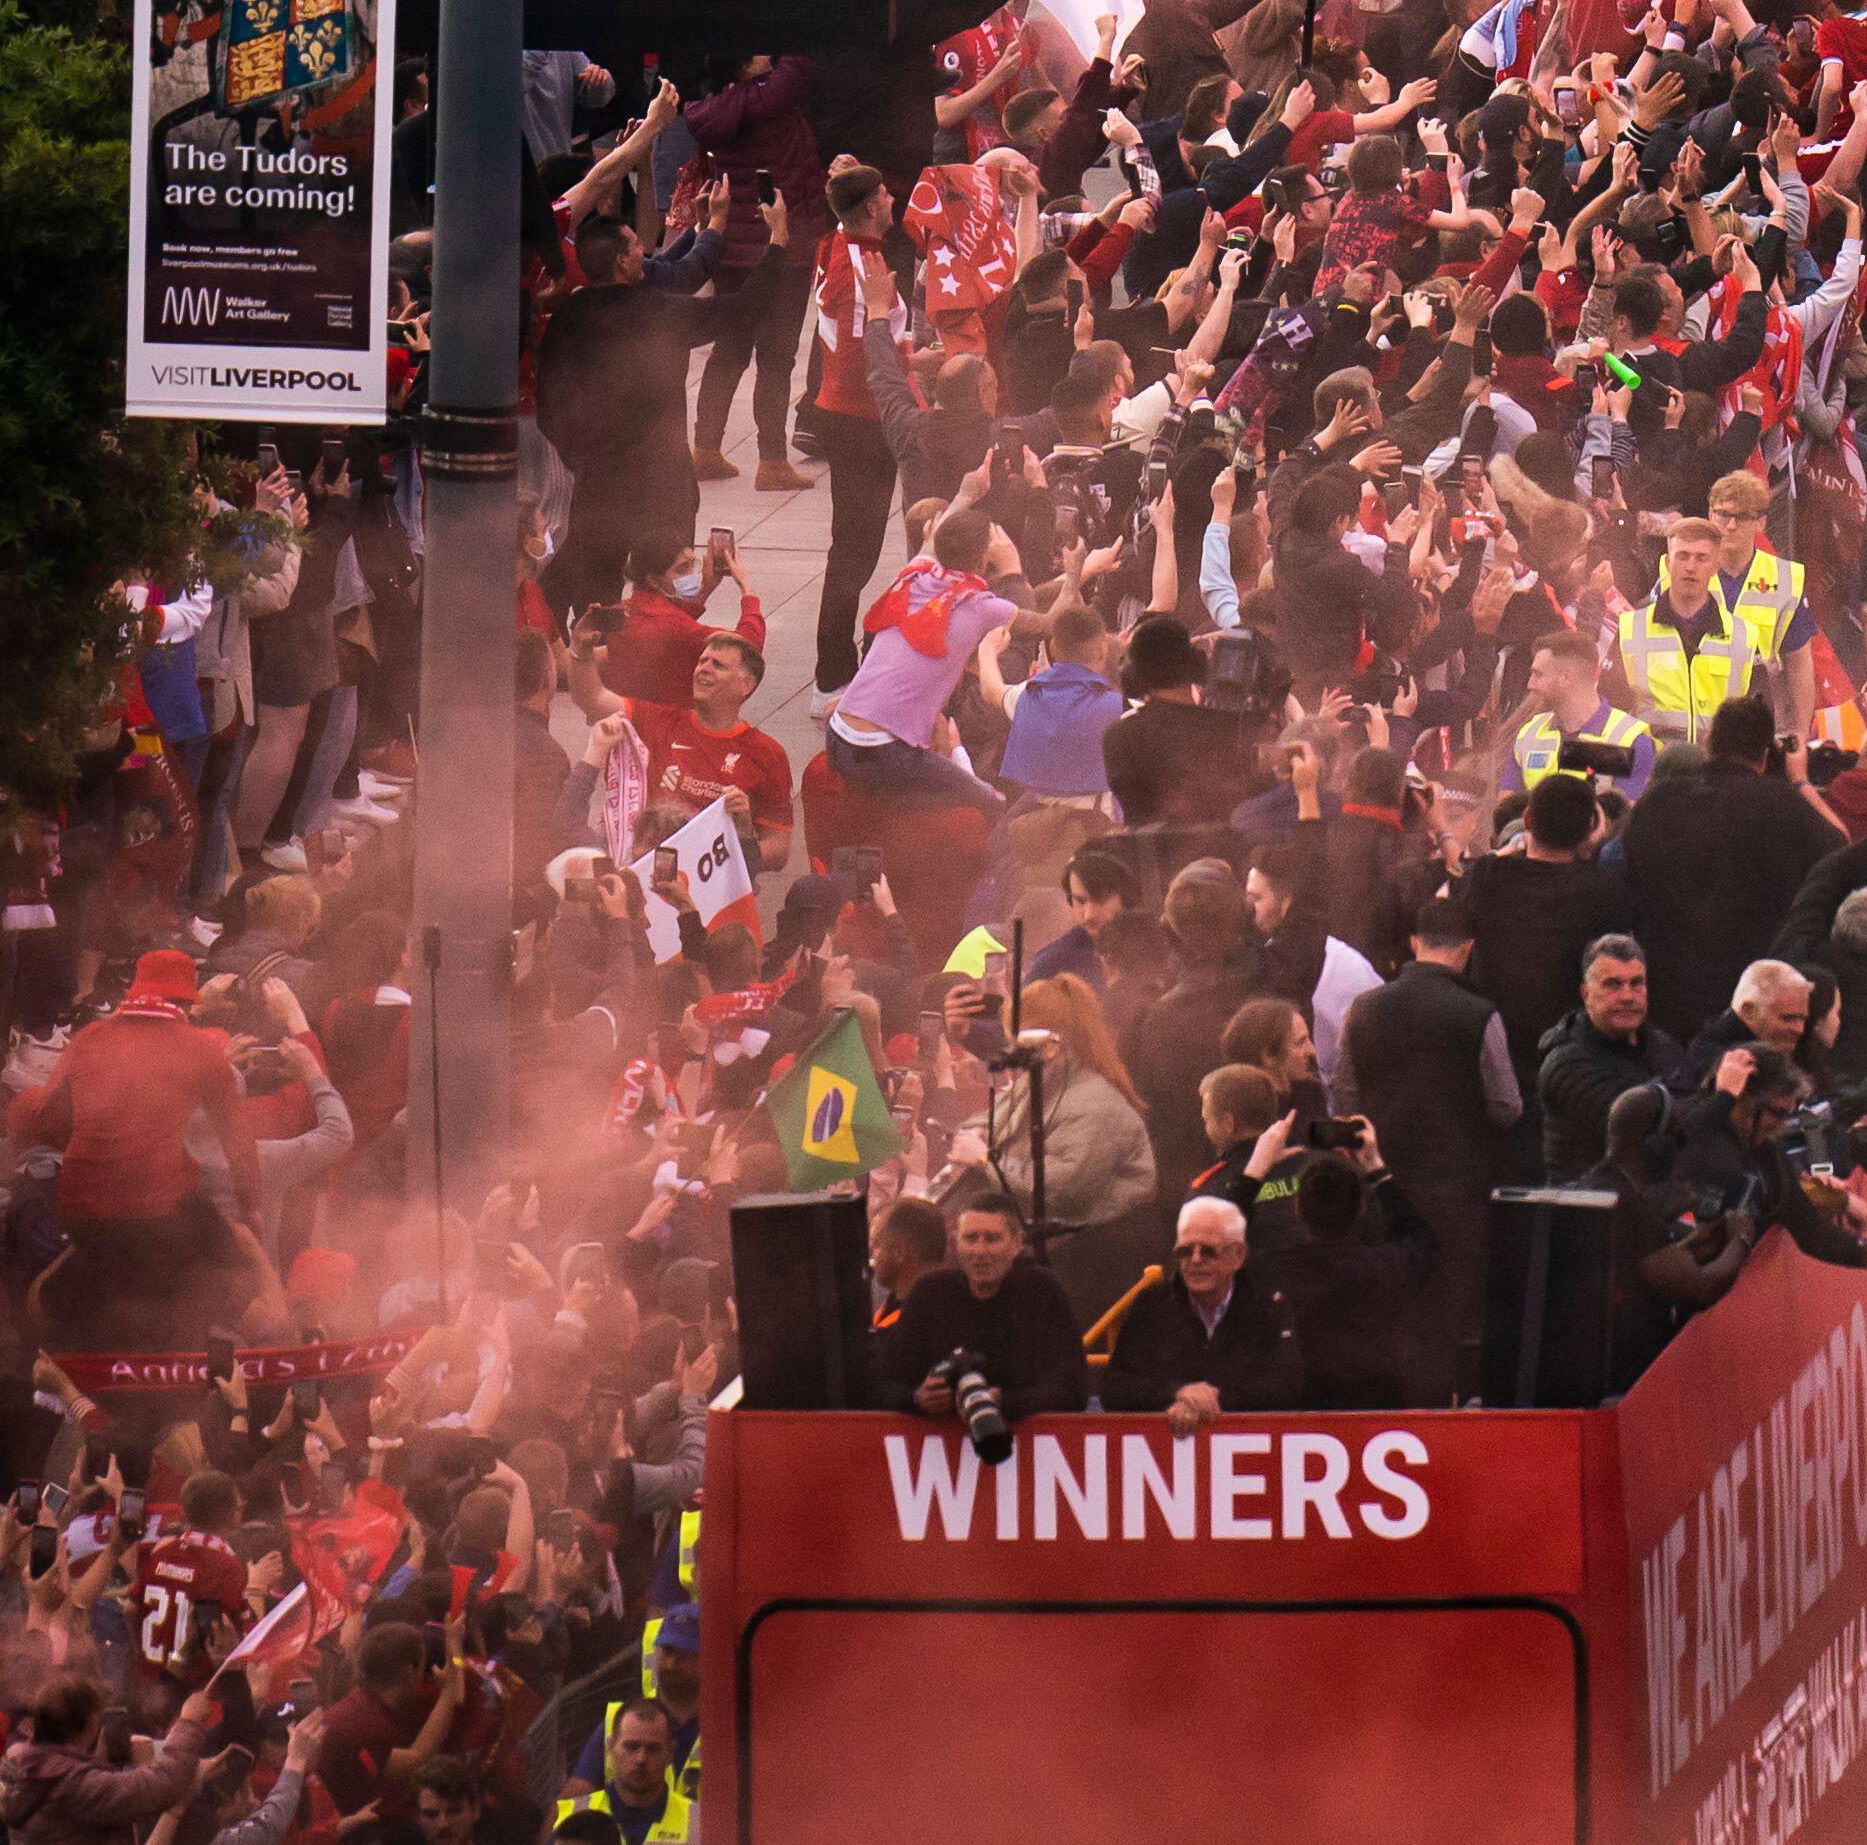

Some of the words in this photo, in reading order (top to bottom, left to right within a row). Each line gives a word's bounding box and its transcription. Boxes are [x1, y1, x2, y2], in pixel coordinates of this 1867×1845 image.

[166, 143, 226, 172] The
[235, 144, 348, 177] Tudors
[166, 185, 217, 205] are
[225, 185, 355, 217] coming!
[163, 243, 187, 253] Book
[189, 245, 213, 255] now,
[216, 245, 261, 257] members
[263, 248, 276, 259] go
[277, 247, 299, 257] free
[226, 296, 268, 308] Walker
[226, 308, 246, 319] Art
[247, 309, 291, 322] Gallery
[152, 365, 362, 392] VISITLIVERPOOL
[884, 1430, 1431, 1542] WINNERS
[141, 1585, 191, 1663] 21
[1643, 1513, 1690, 1802] WE
[1695, 1442, 1753, 1744] ARE
